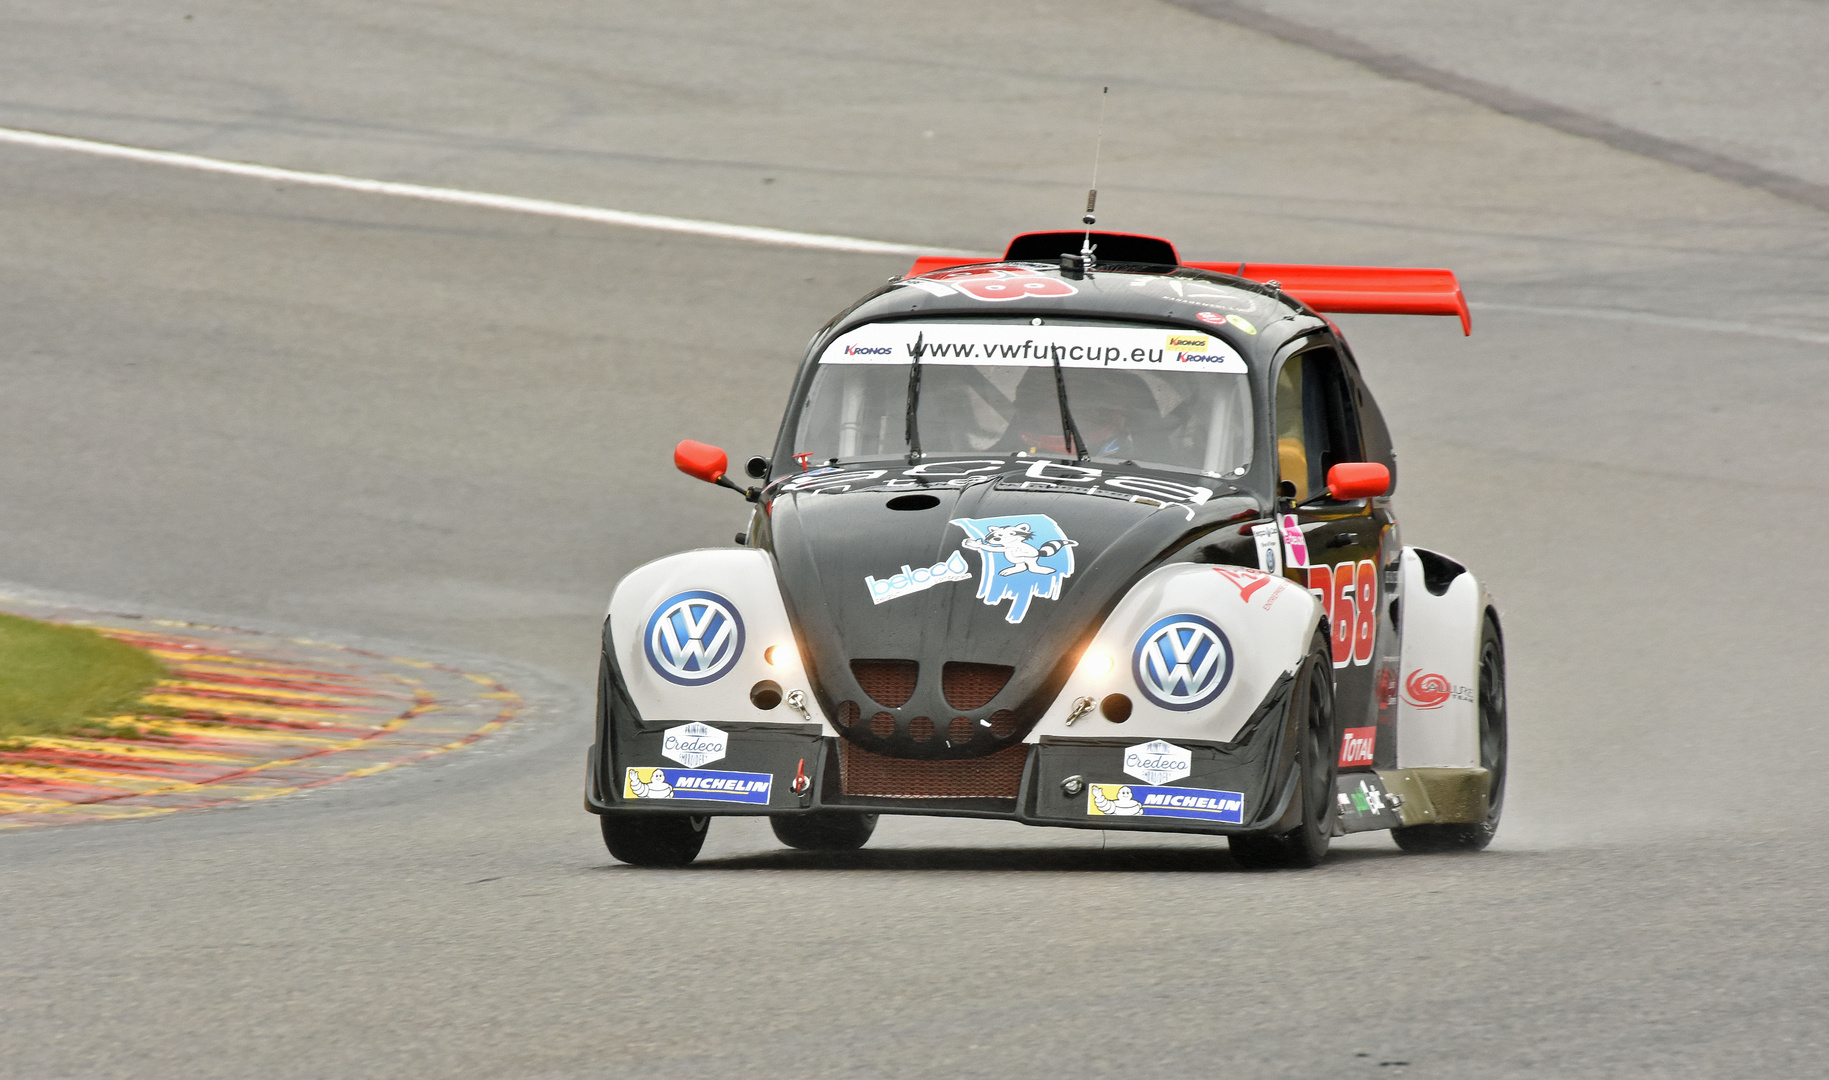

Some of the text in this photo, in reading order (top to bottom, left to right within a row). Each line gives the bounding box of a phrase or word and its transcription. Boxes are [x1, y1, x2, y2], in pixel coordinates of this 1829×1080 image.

[844, 343, 892, 356] KRONOS
[906, 340, 1164, 366] www.vwfuncup.eu
[1176, 351, 1225, 364] KRONOS
[665, 735, 724, 753] Credeco
[1342, 732, 1374, 762] TOTAL
[1126, 753, 1189, 771] Credeco
[675, 776, 769, 793] MICHELIN
[1144, 794, 1241, 812] MICHELIN
